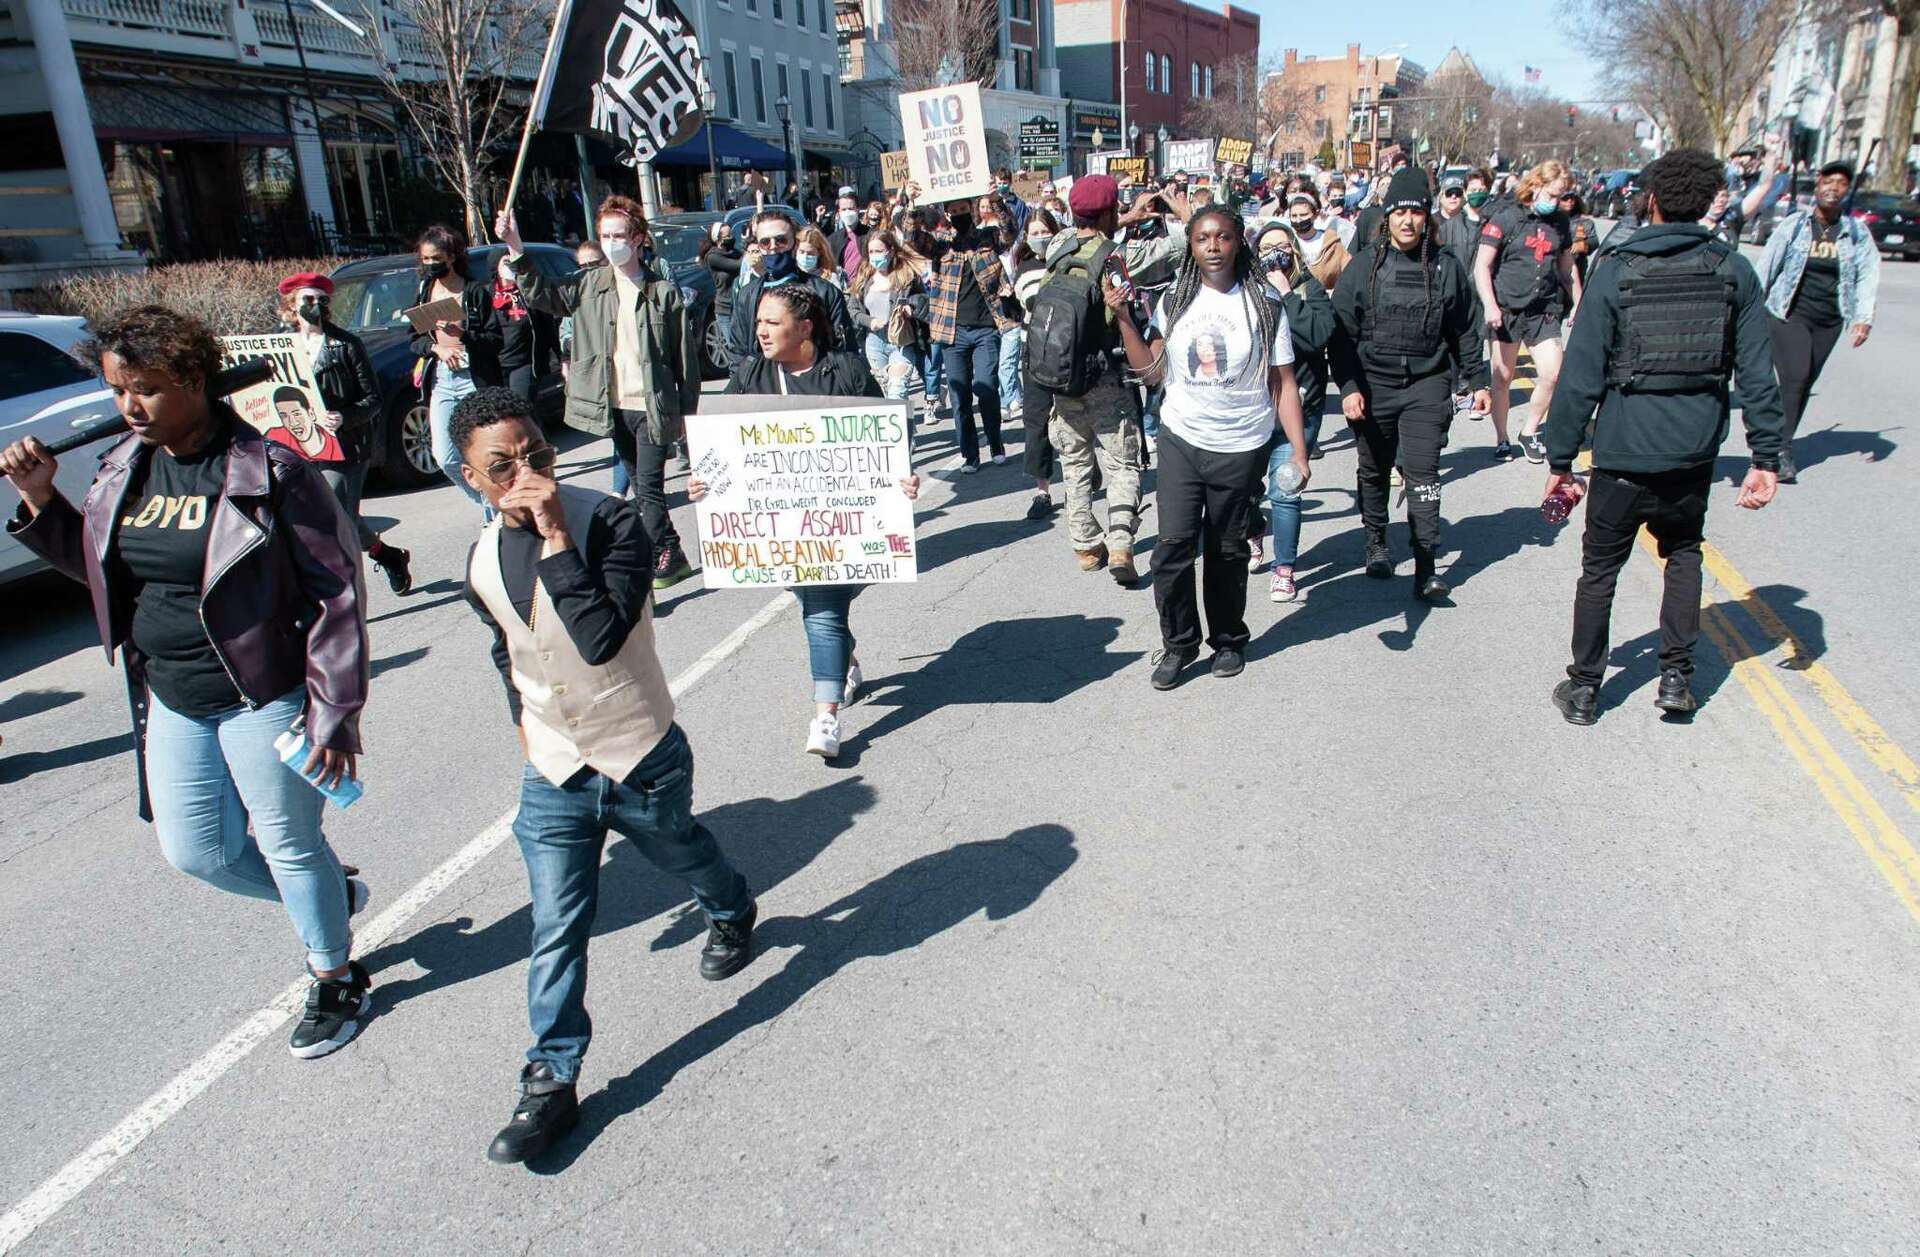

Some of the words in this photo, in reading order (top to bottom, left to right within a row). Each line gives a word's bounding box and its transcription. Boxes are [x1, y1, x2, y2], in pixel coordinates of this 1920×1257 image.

[918, 94, 963, 130] NO
[923, 126, 966, 142] JUSTICE
[1170, 142, 1209, 157] ADOPT
[1220, 136, 1253, 152] ADOPT
[926, 140, 971, 174] NO
[1110, 158, 1145, 170] ADOPT
[930, 171, 974, 190] PEACE
[222, 339, 267, 351] USTICE
[270, 338, 294, 349] FOR
[821, 414, 903, 443] INJURIES
[744, 453, 768, 468] ARE
[767, 446, 895, 474] INCONSISTENT
[746, 478, 773, 492] WITH
[777, 477, 791, 490] AN
[793, 476, 867, 494] ACCIDENTAL
[871, 477, 893, 489] FALL
[748, 497, 763, 511] DR
[765, 496, 791, 511] CYRIL
[826, 496, 877, 508] CONCLUDED
[710, 511, 780, 539] DIRECT
[800, 509, 865, 537] ASSAULT
[702, 540, 767, 569] PHYSICAL
[768, 540, 845, 567] BEATING
[860, 541, 887, 555] was
[885, 533, 912, 554] THE
[732, 566, 777, 584] CAUSE
